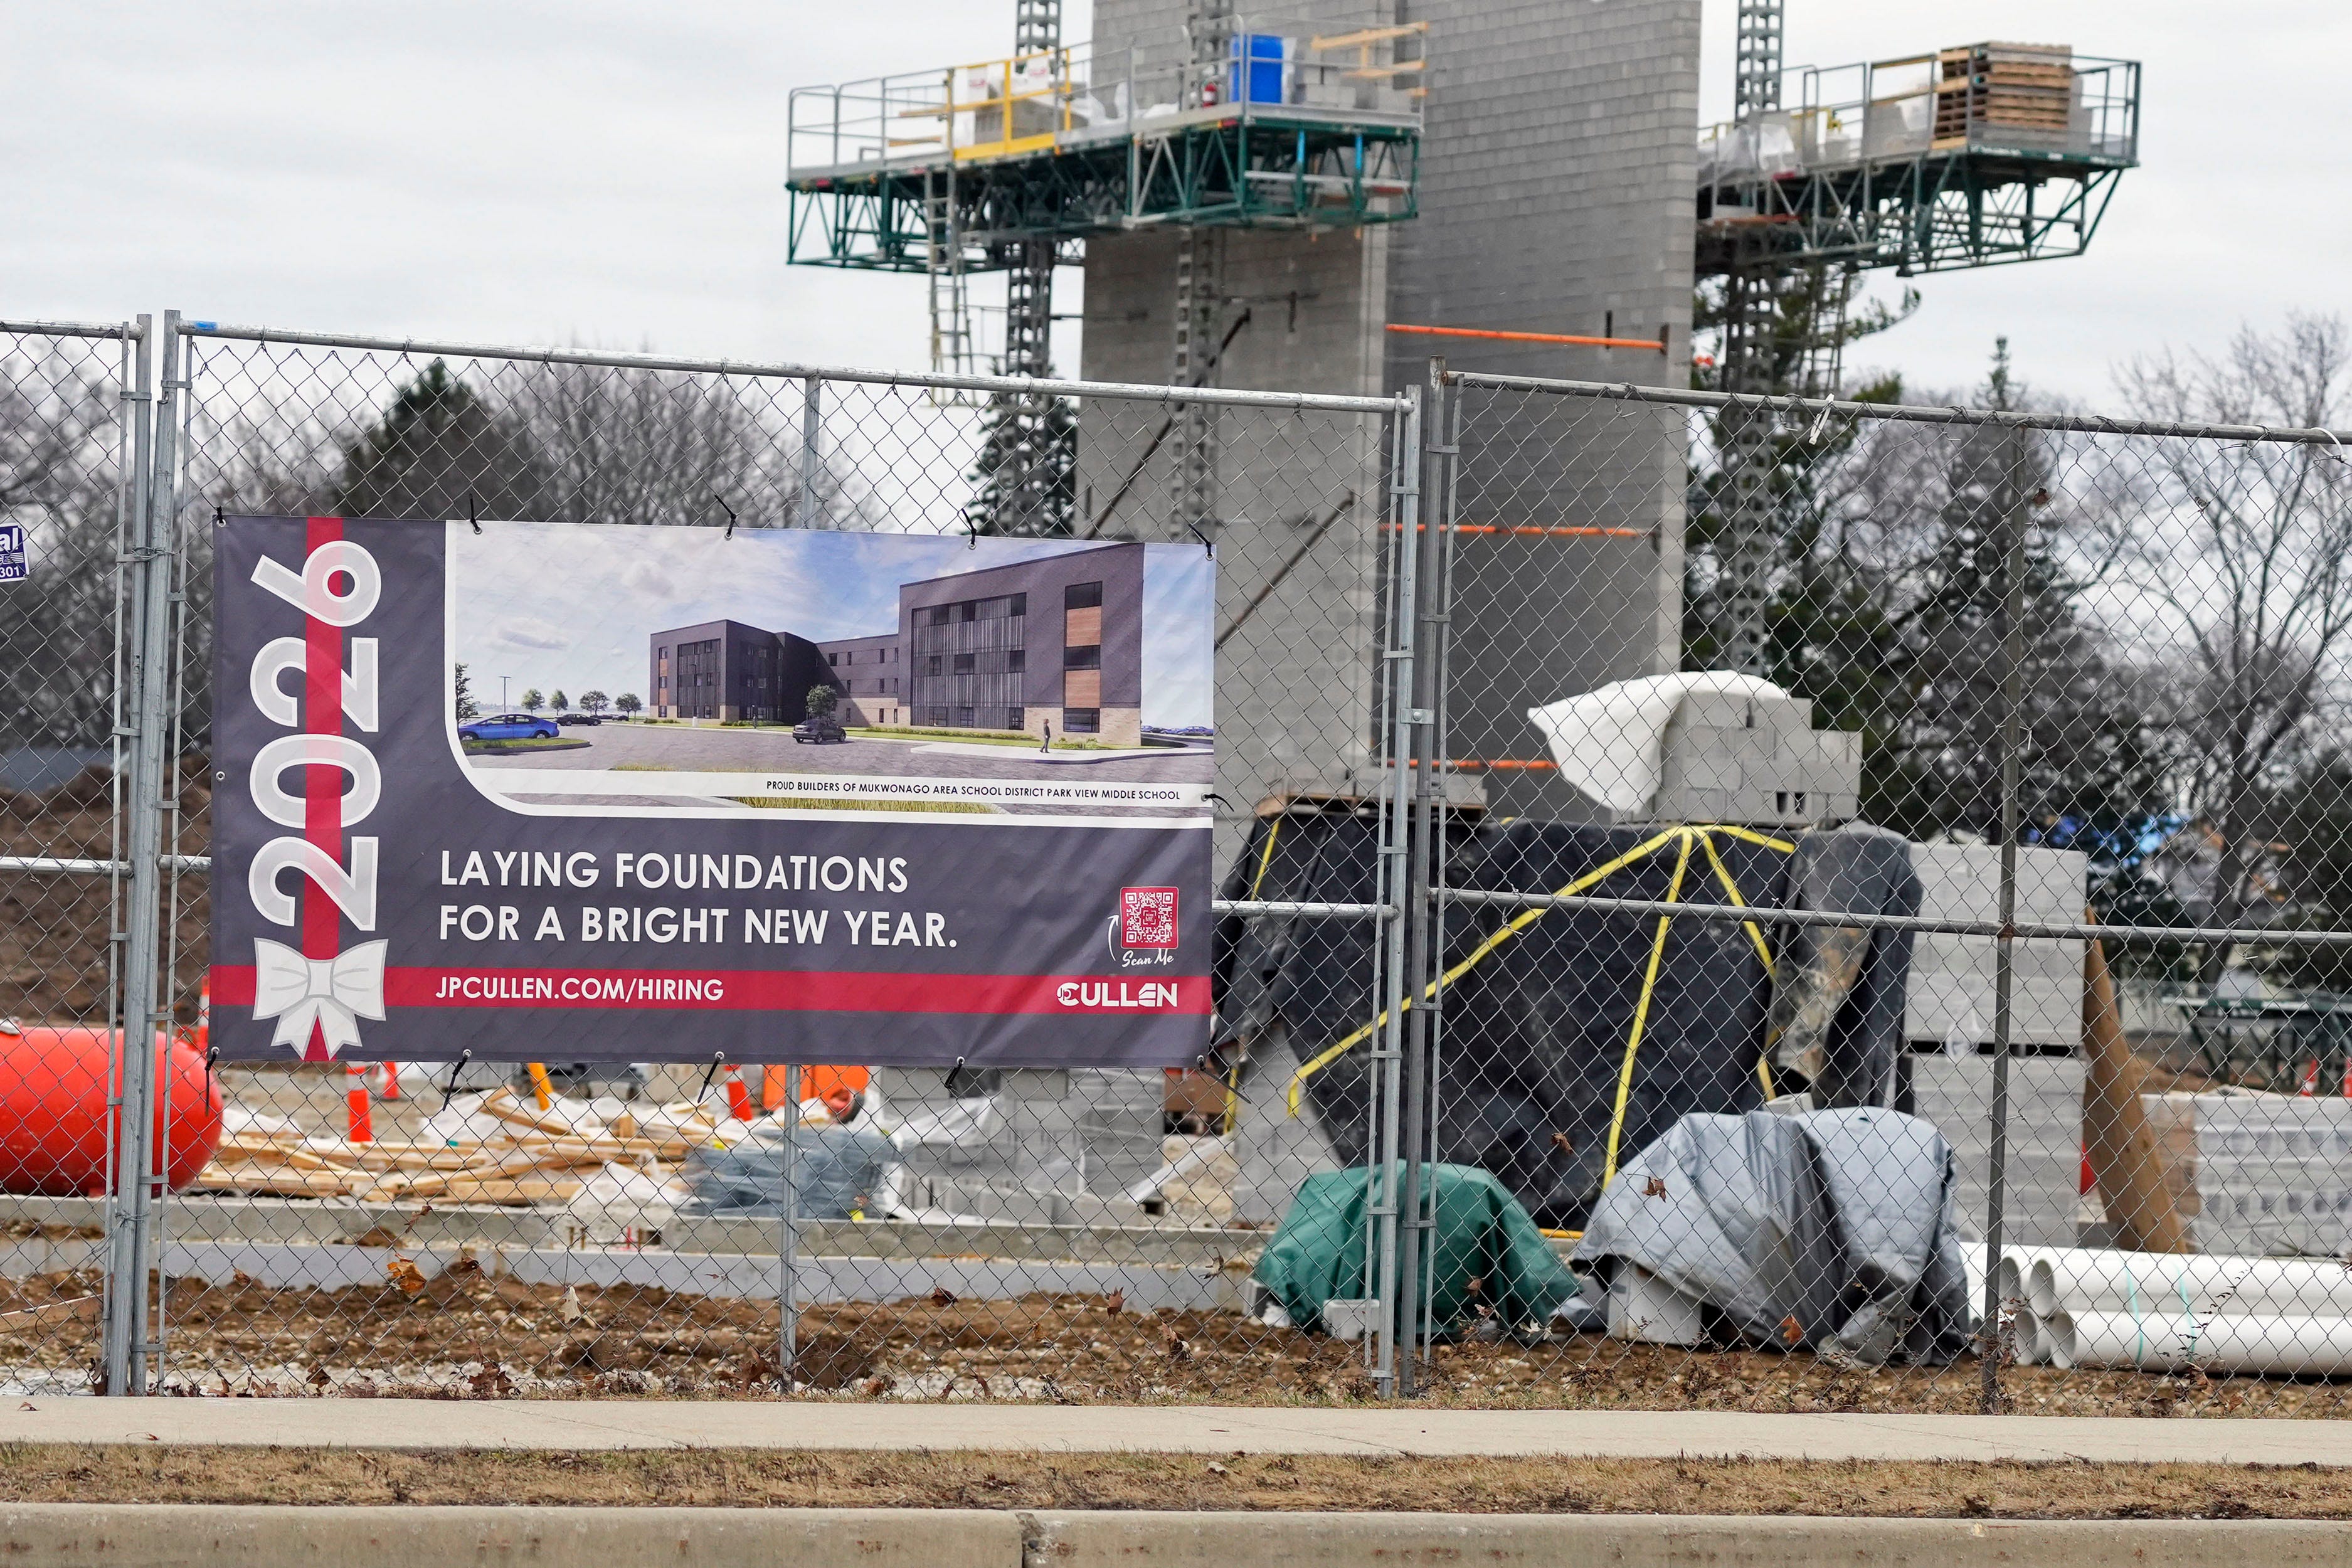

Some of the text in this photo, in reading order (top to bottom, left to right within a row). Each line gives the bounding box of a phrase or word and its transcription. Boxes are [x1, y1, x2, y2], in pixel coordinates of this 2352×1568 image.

[248, 540, 381, 931] 2026
[766, 781, 1180, 800] PROUD BUILDERS OF MUKWONAGO AREA SCHOOL DISTRICT PARK VIEW MIDDLE SCHOOL
[442, 850, 908, 893] LAYING FOUNDATIONS
[440, 905, 958, 947] FOR A BRIGHT NEW YEAR.
[1121, 948, 1174, 968] Scan Me
[436, 977, 724, 1003] JPCULLEN.COM/HIRING
